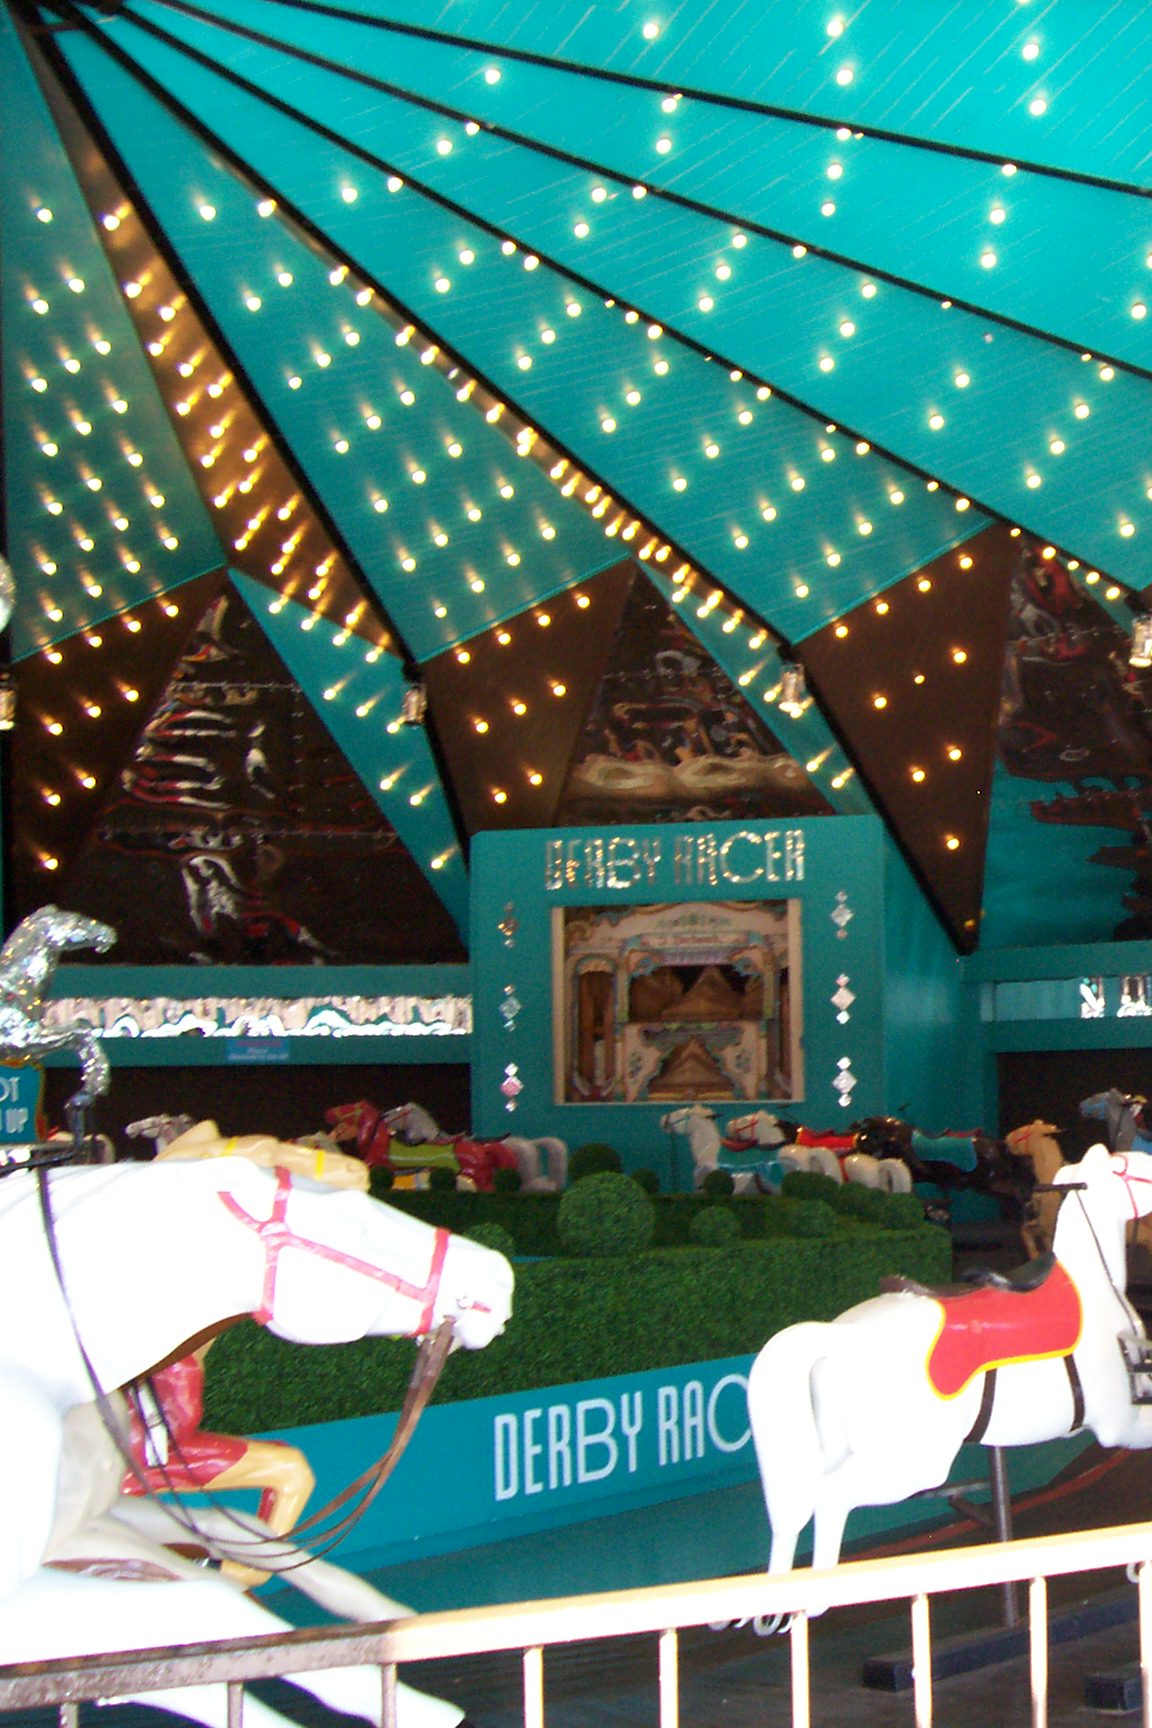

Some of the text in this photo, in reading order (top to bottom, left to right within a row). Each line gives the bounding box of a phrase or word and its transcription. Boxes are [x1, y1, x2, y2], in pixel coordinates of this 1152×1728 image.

[545, 829, 805, 890] DERBY RACER
[494, 1391, 643, 1501] DERBY
